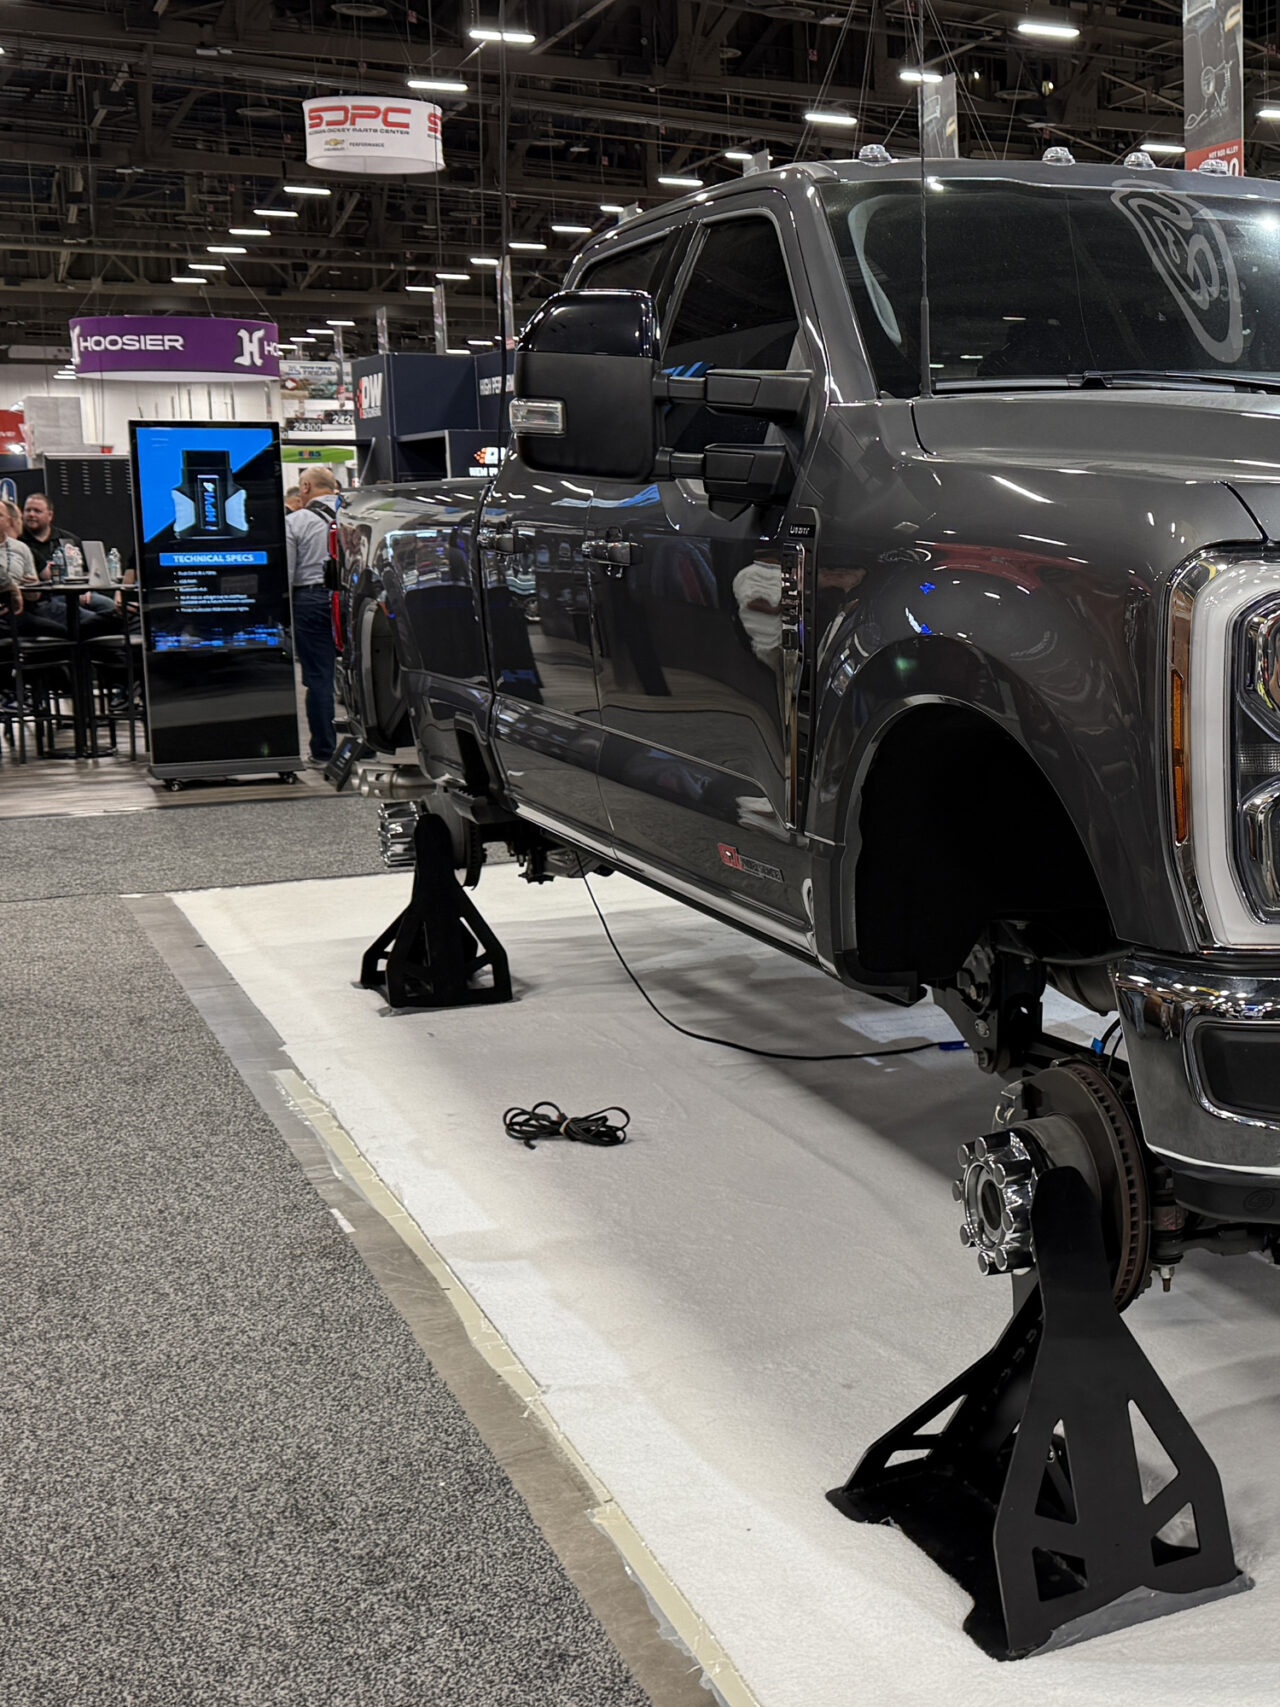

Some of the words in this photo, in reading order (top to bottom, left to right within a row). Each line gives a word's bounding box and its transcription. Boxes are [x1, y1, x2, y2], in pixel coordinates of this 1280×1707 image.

[80, 334, 184, 352] HOOSIER
[293, 421, 322, 432] 24300
[173, 554, 225, 563] TECHNICAL
[225, 553, 255, 562] SPECS
